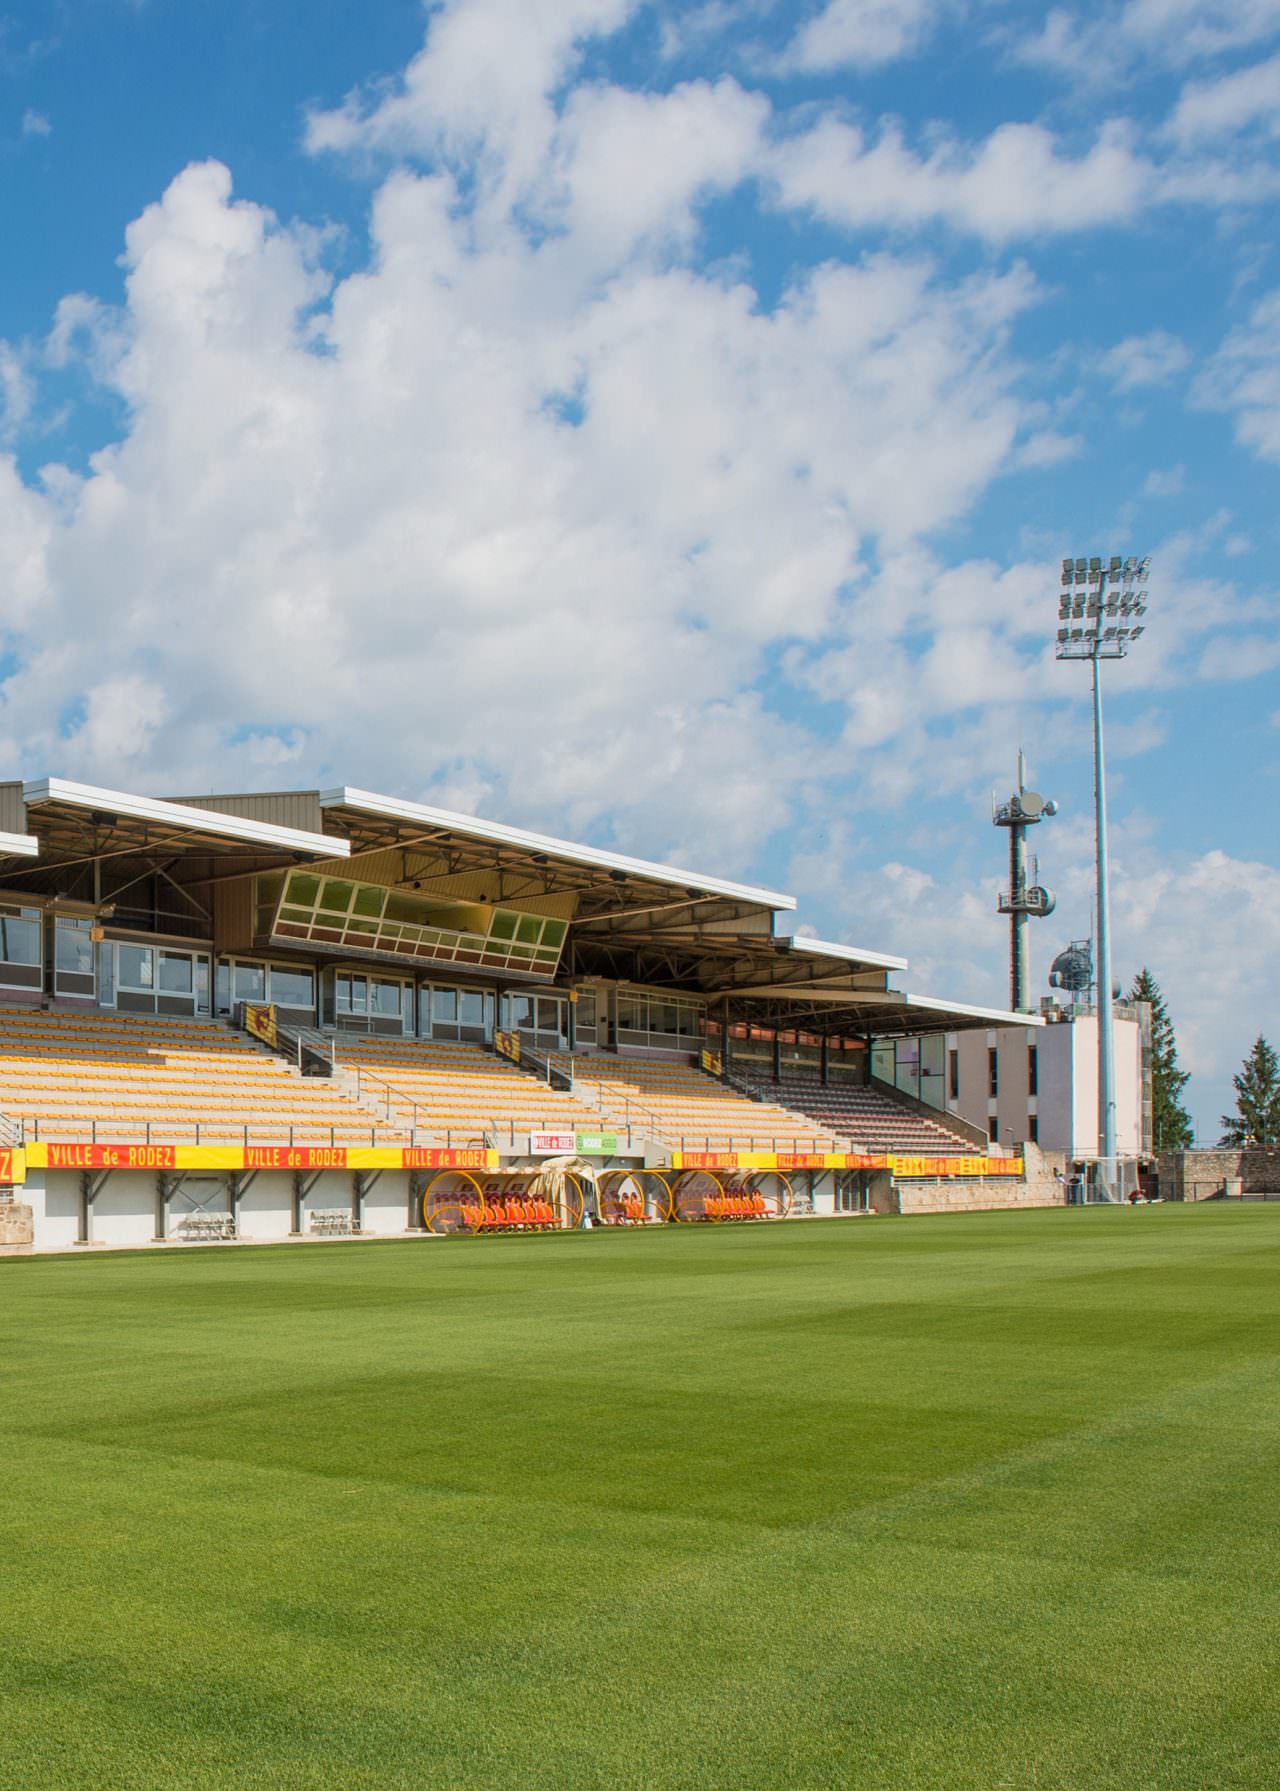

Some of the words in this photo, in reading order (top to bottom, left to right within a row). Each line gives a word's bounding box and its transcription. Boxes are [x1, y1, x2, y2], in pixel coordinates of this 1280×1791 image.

[51, 1146, 92, 1165] VILLE
[102, 1147, 119, 1165] de
[128, 1147, 171, 1166] RODEZ
[247, 1148, 279, 1166] VILLE
[288, 1149, 300, 1166] de
[308, 1149, 343, 1166] RODEZ
[404, 1150, 432, 1166] VILLE
[439, 1151, 450, 1166] de
[455, 1150, 486, 1167] RODEZ
